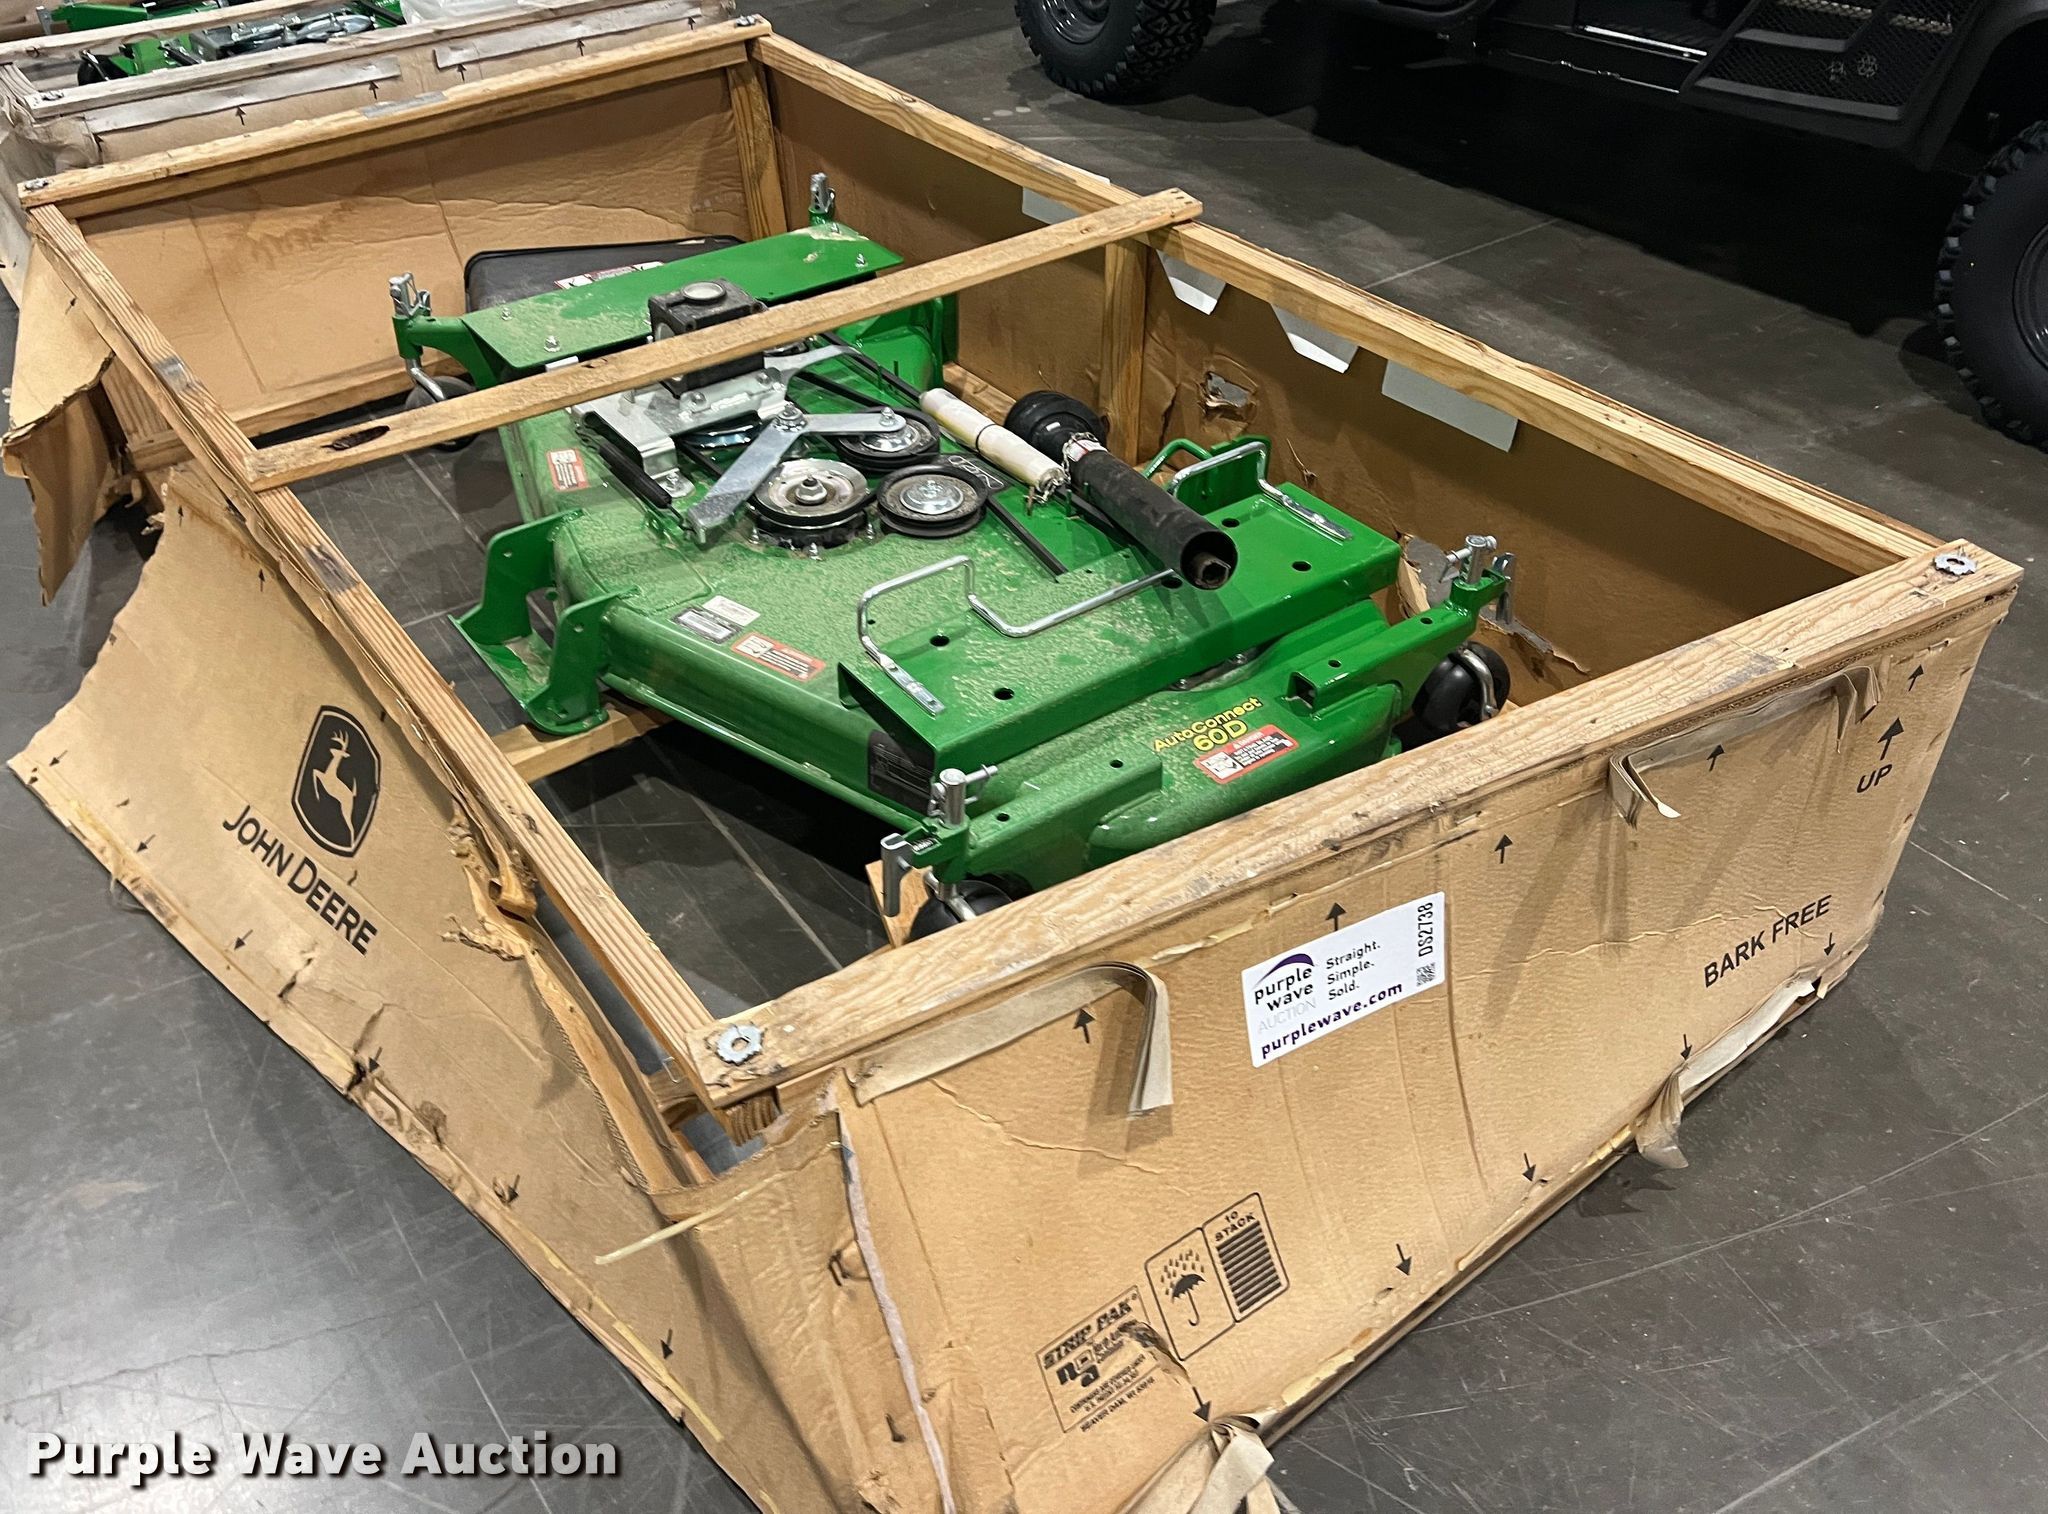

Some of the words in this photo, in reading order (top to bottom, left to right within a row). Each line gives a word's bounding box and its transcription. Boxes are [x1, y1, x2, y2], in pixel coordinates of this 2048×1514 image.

[1154, 697, 1263, 752] AutoConnect
[1193, 719, 1248, 751] 60D
[1857, 764, 1892, 793] UP
[222, 804, 294, 877] JOHN
[287, 856, 378, 956] DEERE
[1417, 902, 1433, 957] DS2738
[1704, 931, 1765, 988] BARK
[1772, 895, 1832, 943] FREE
[1326, 940, 1381, 970] Straight.
[1327, 959, 1375, 985] Simple.
[1254, 966, 1313, 1004] purple
[1267, 983, 1313, 1012] wave
[1328, 981, 1360, 1001] Sold.
[1258, 998, 1317, 1034] AUCTION
[1261, 983, 1403, 1059] purplewave.com
[1215, 1212, 1257, 1242] STACK
